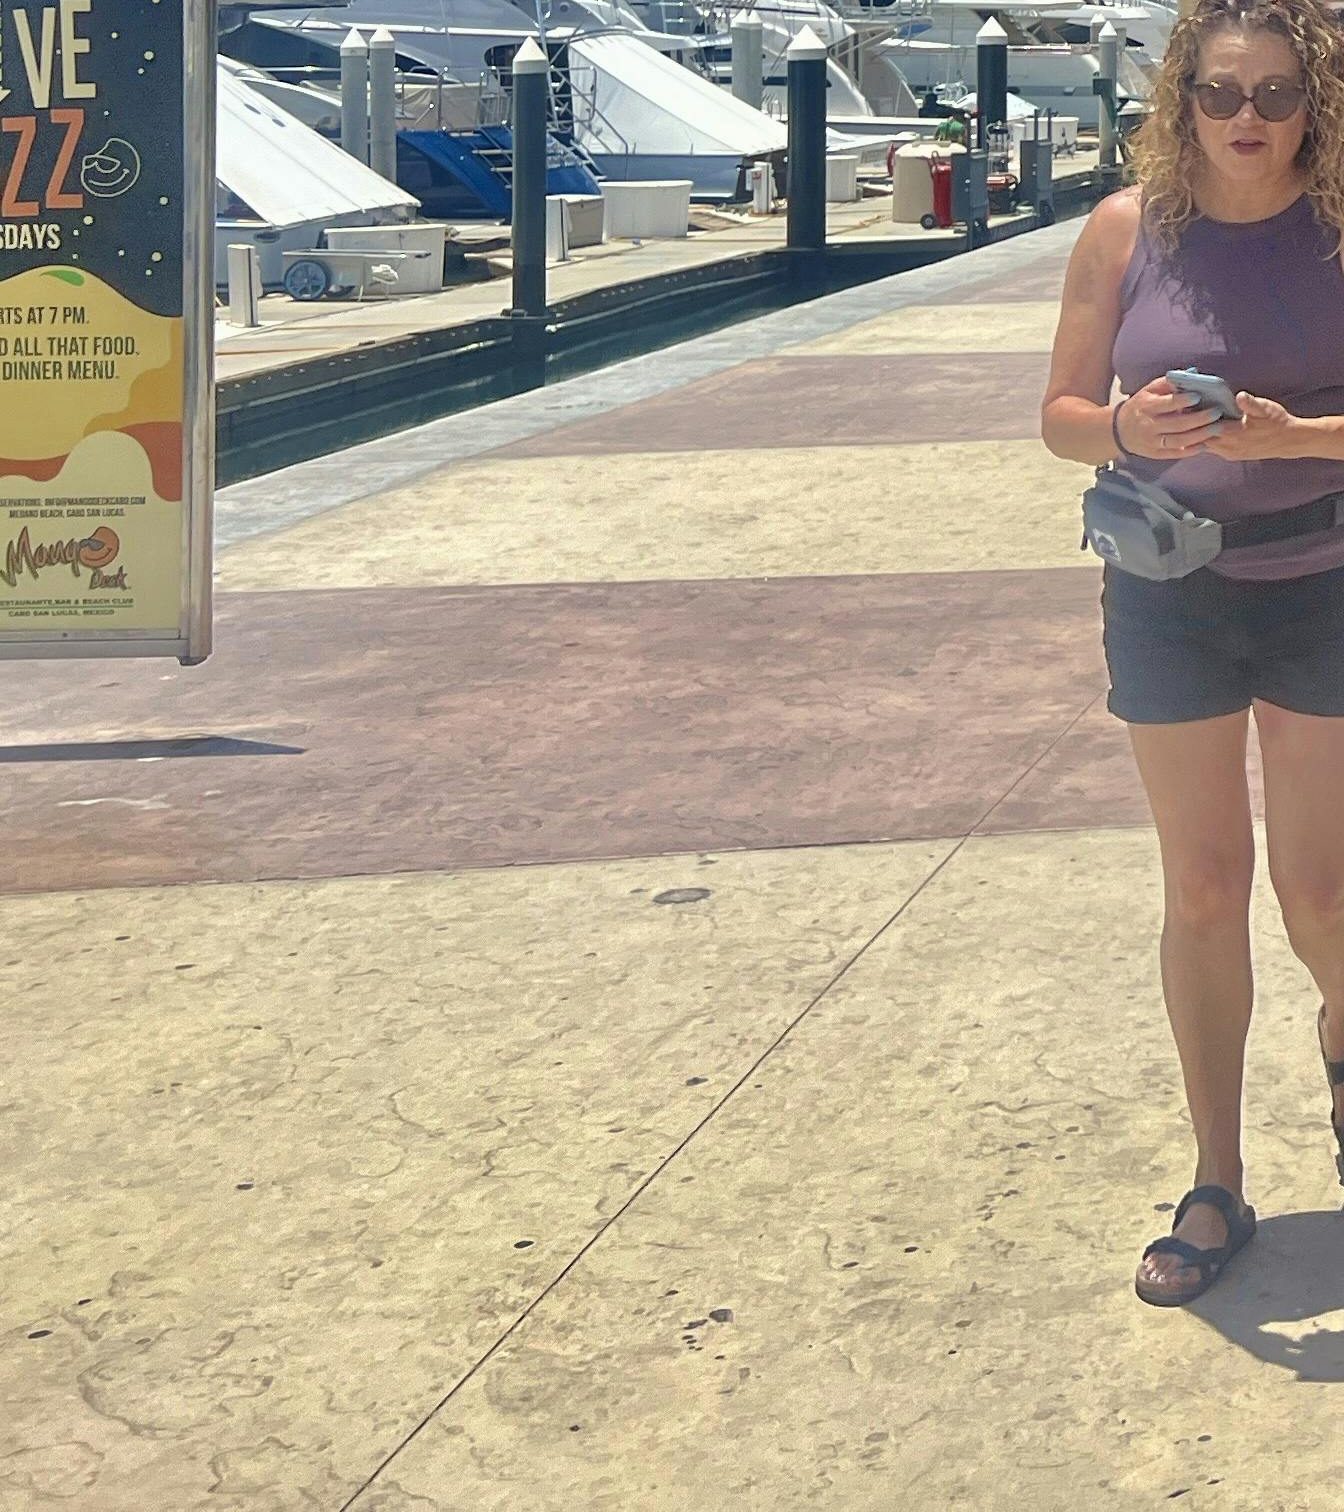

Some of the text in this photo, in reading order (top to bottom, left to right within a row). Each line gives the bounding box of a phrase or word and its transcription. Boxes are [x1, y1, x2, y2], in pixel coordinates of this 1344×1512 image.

[27, 306, 45, 325] AT
[50, 306, 59, 325] 7
[63, 306, 90, 325] PM.
[13, 337, 43, 356] ALL
[48, 337, 88, 356] THAT
[2, 360, 120, 381] DINNER MENU.
[86, 508, 101, 518] SAN
